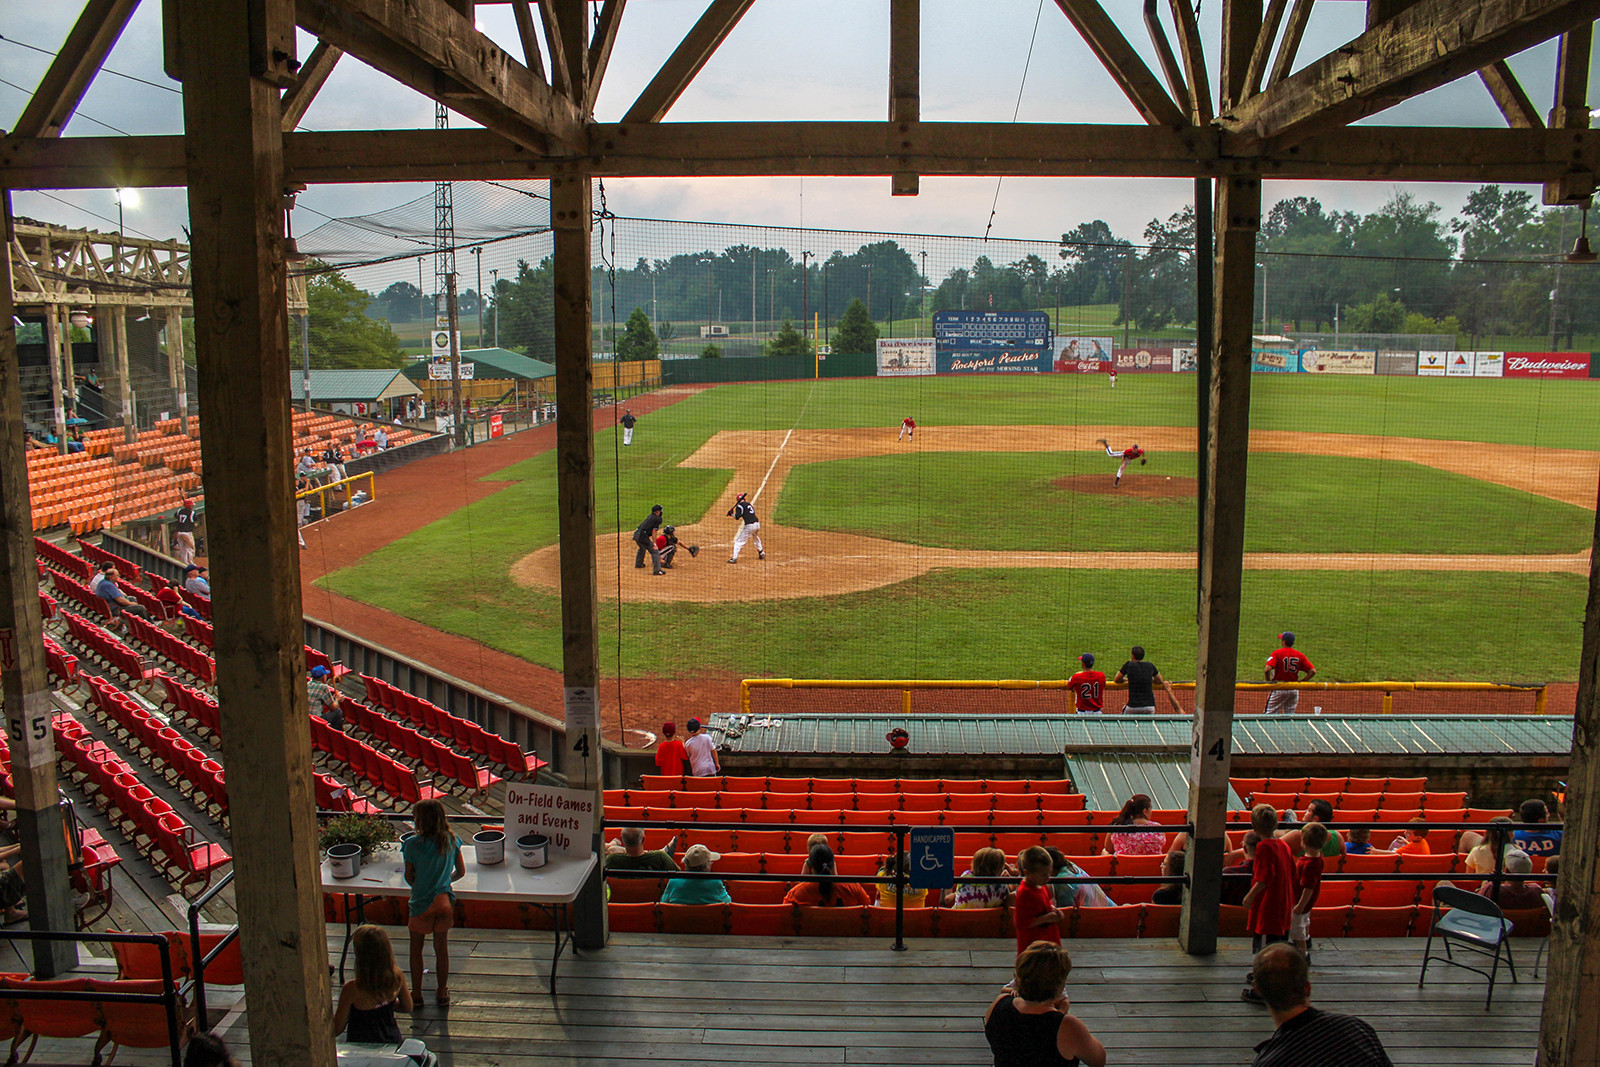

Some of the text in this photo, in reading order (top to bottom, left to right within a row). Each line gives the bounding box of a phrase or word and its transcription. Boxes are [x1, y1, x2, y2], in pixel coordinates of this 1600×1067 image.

[951, 352, 1040, 370] Rockford Peaches
[1507, 357, 1587, 370] Budweiser
[747, 505, 755, 514] 3
[1282, 656, 1300, 673] 15
[1081, 681, 1099, 699] 21
[11, 718, 23, 742] 5
[32, 716, 47, 740] 5
[573, 734, 589, 757] 4
[1208, 737, 1224, 761] 4
[508, 790, 592, 813] On-Field Games
[517, 812, 580, 831] and Events
[556, 833, 571, 851] Up
[913, 835, 951, 844] HANDICAPPED
[1515, 839, 1555, 852] DAD
